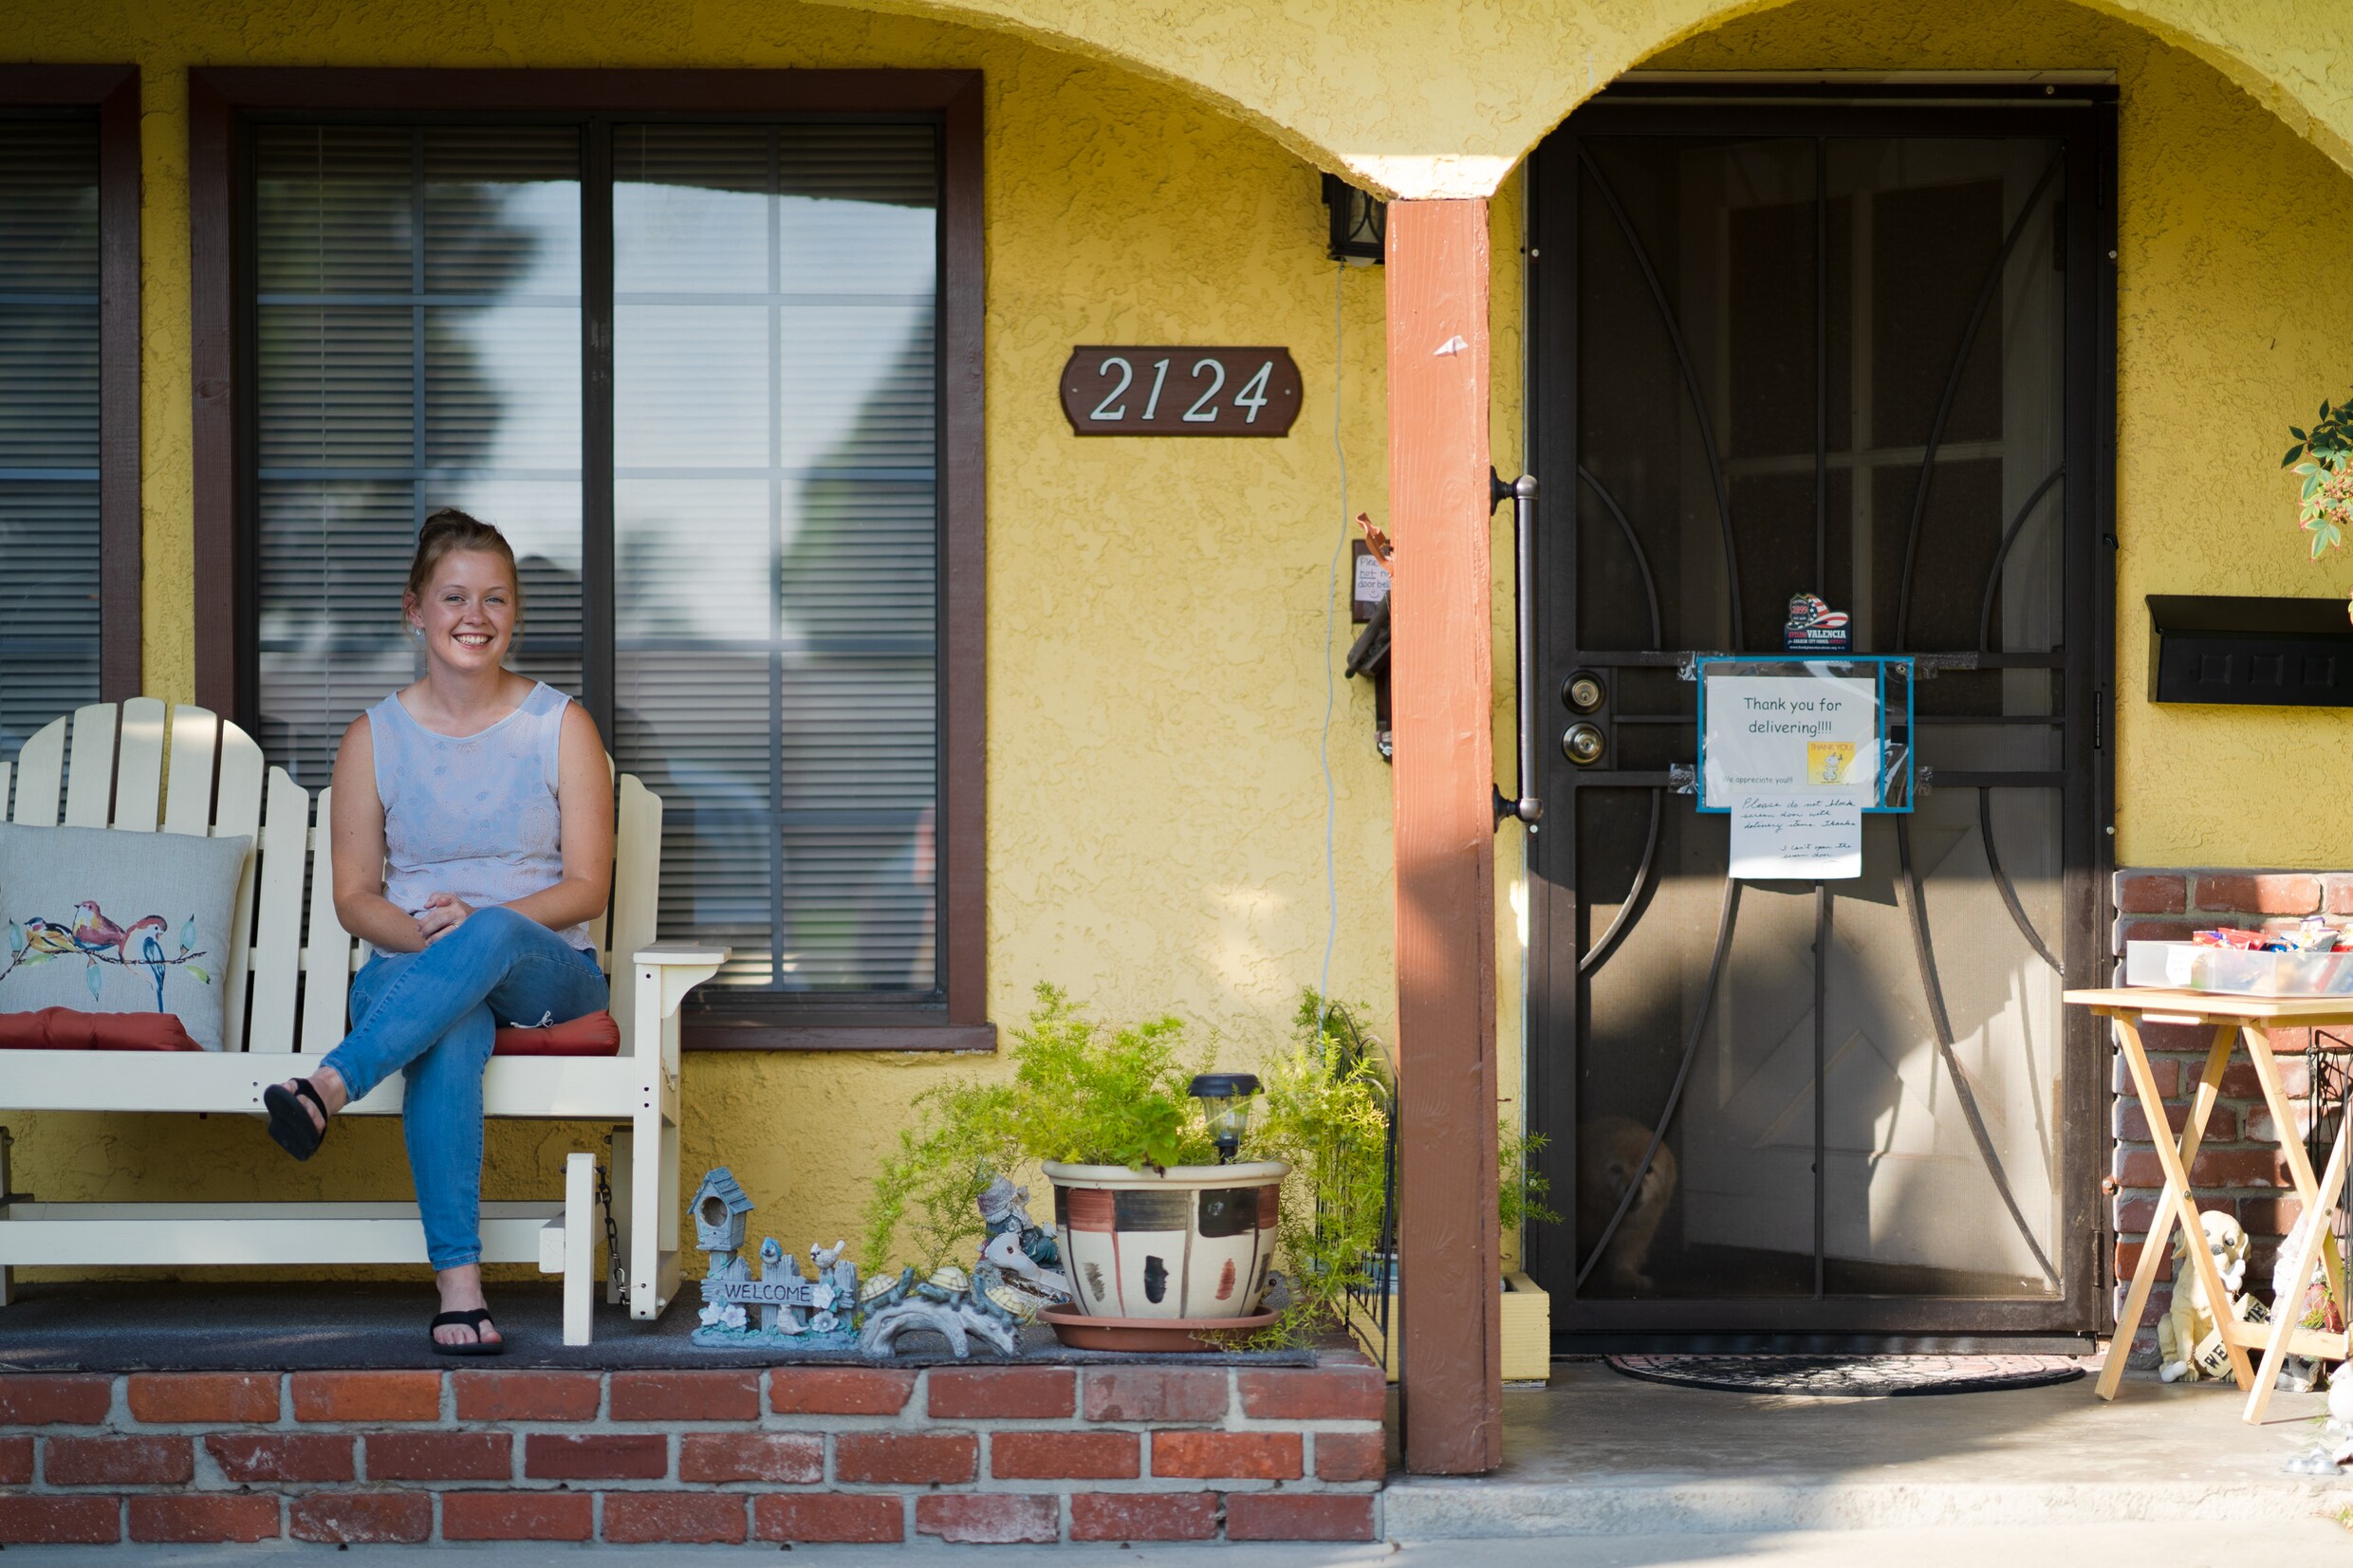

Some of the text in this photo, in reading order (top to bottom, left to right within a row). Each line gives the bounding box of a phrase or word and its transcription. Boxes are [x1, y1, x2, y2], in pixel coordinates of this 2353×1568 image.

[1090, 357, 1273, 423] 2124
[1360, 569, 1377, 578] not
[1806, 629, 1846, 638] VALENCIA
[1744, 697, 1842, 714] Thank you for
[1749, 720, 1832, 737] delivering!!!!
[1735, 776, 1773, 785] appreciate
[1742, 798, 1781, 809] Please
[1744, 821, 1783, 833] delivery
[725, 1283, 811, 1302] WELCOME
[2204, 1302, 2268, 1368] WEME
